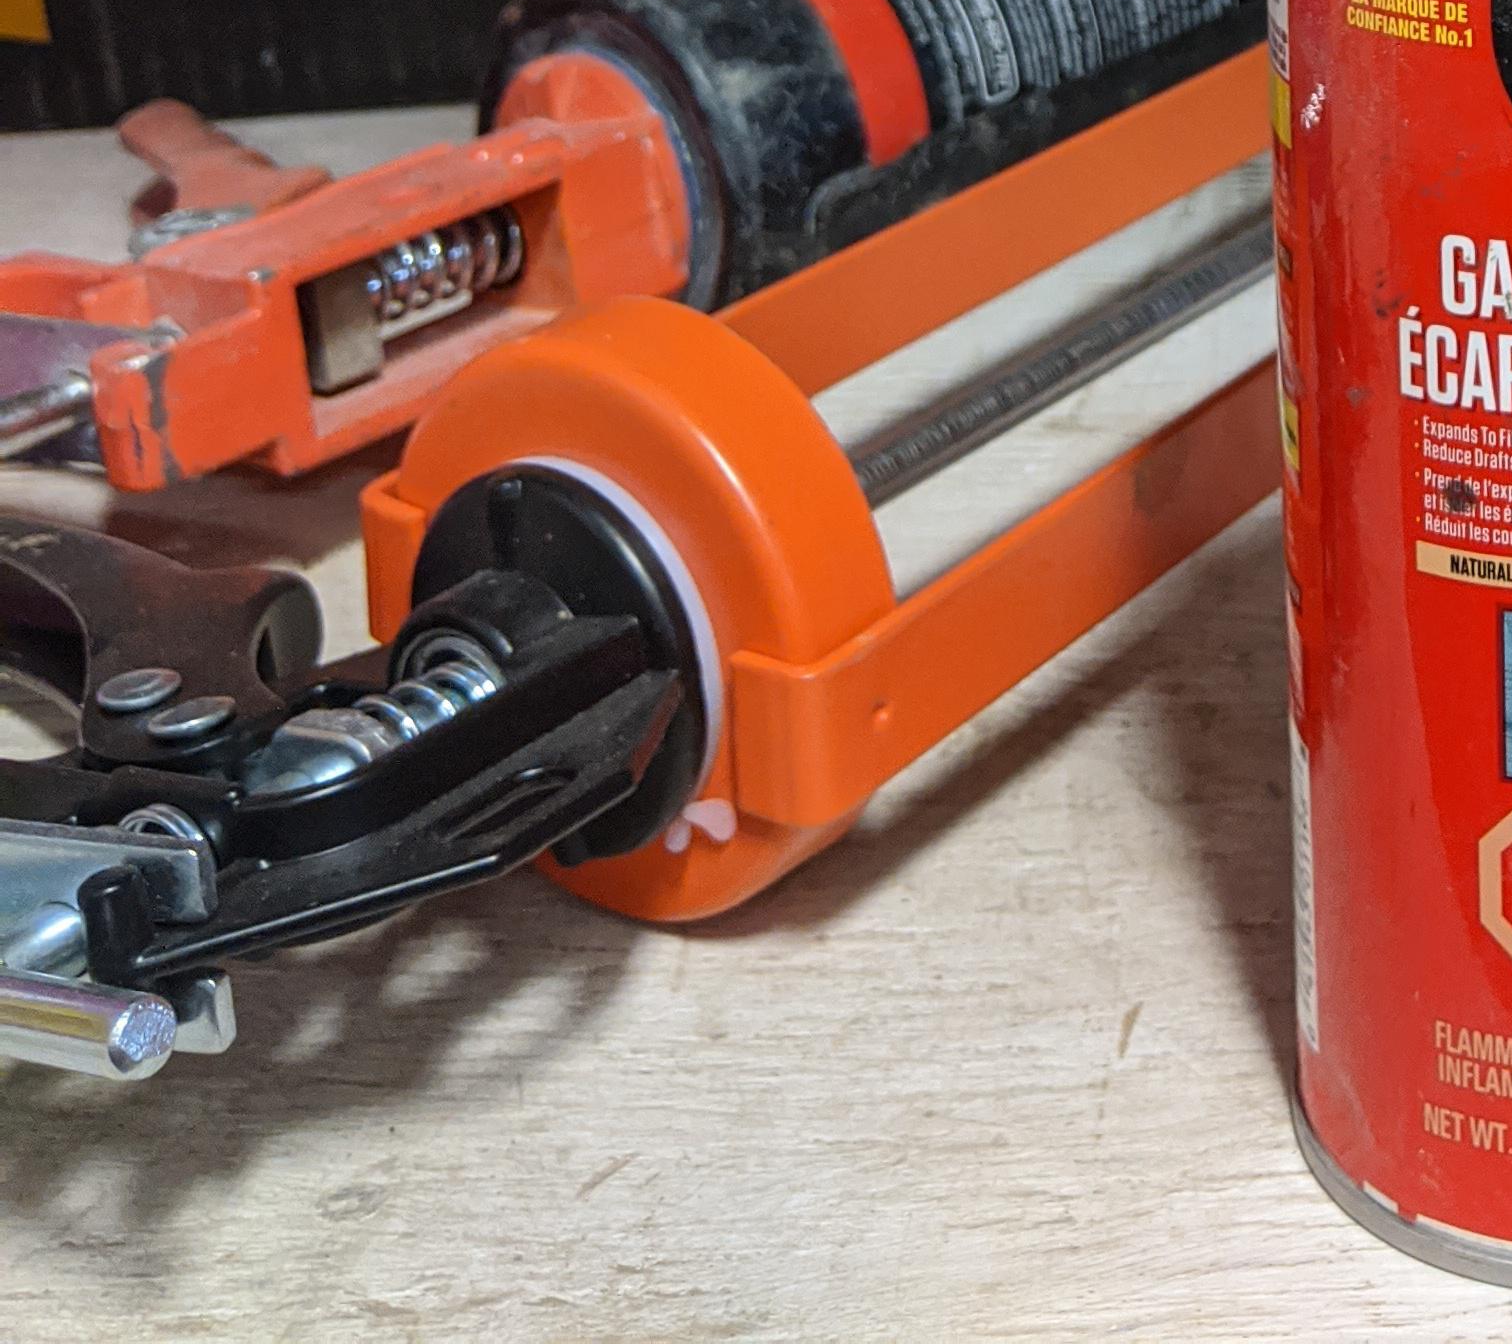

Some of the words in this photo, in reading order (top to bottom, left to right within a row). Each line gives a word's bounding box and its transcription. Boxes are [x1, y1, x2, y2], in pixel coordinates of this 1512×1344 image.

[1346, 6, 1431, 42] CONFIANCE
[1435, 24, 1473, 48] No.1
[1445, 1, 1469, 24] DE
[1422, 415, 1479, 445] Expands
[1480, 426, 1497, 447] To
[1423, 438, 1472, 466] Reduce
[1424, 493, 1437, 511] et
[1479, 500, 1501, 522] les
[1425, 512, 1467, 539] Réduit
[1469, 521, 1490, 542] les
[1423, 1101, 1465, 1143] NET
